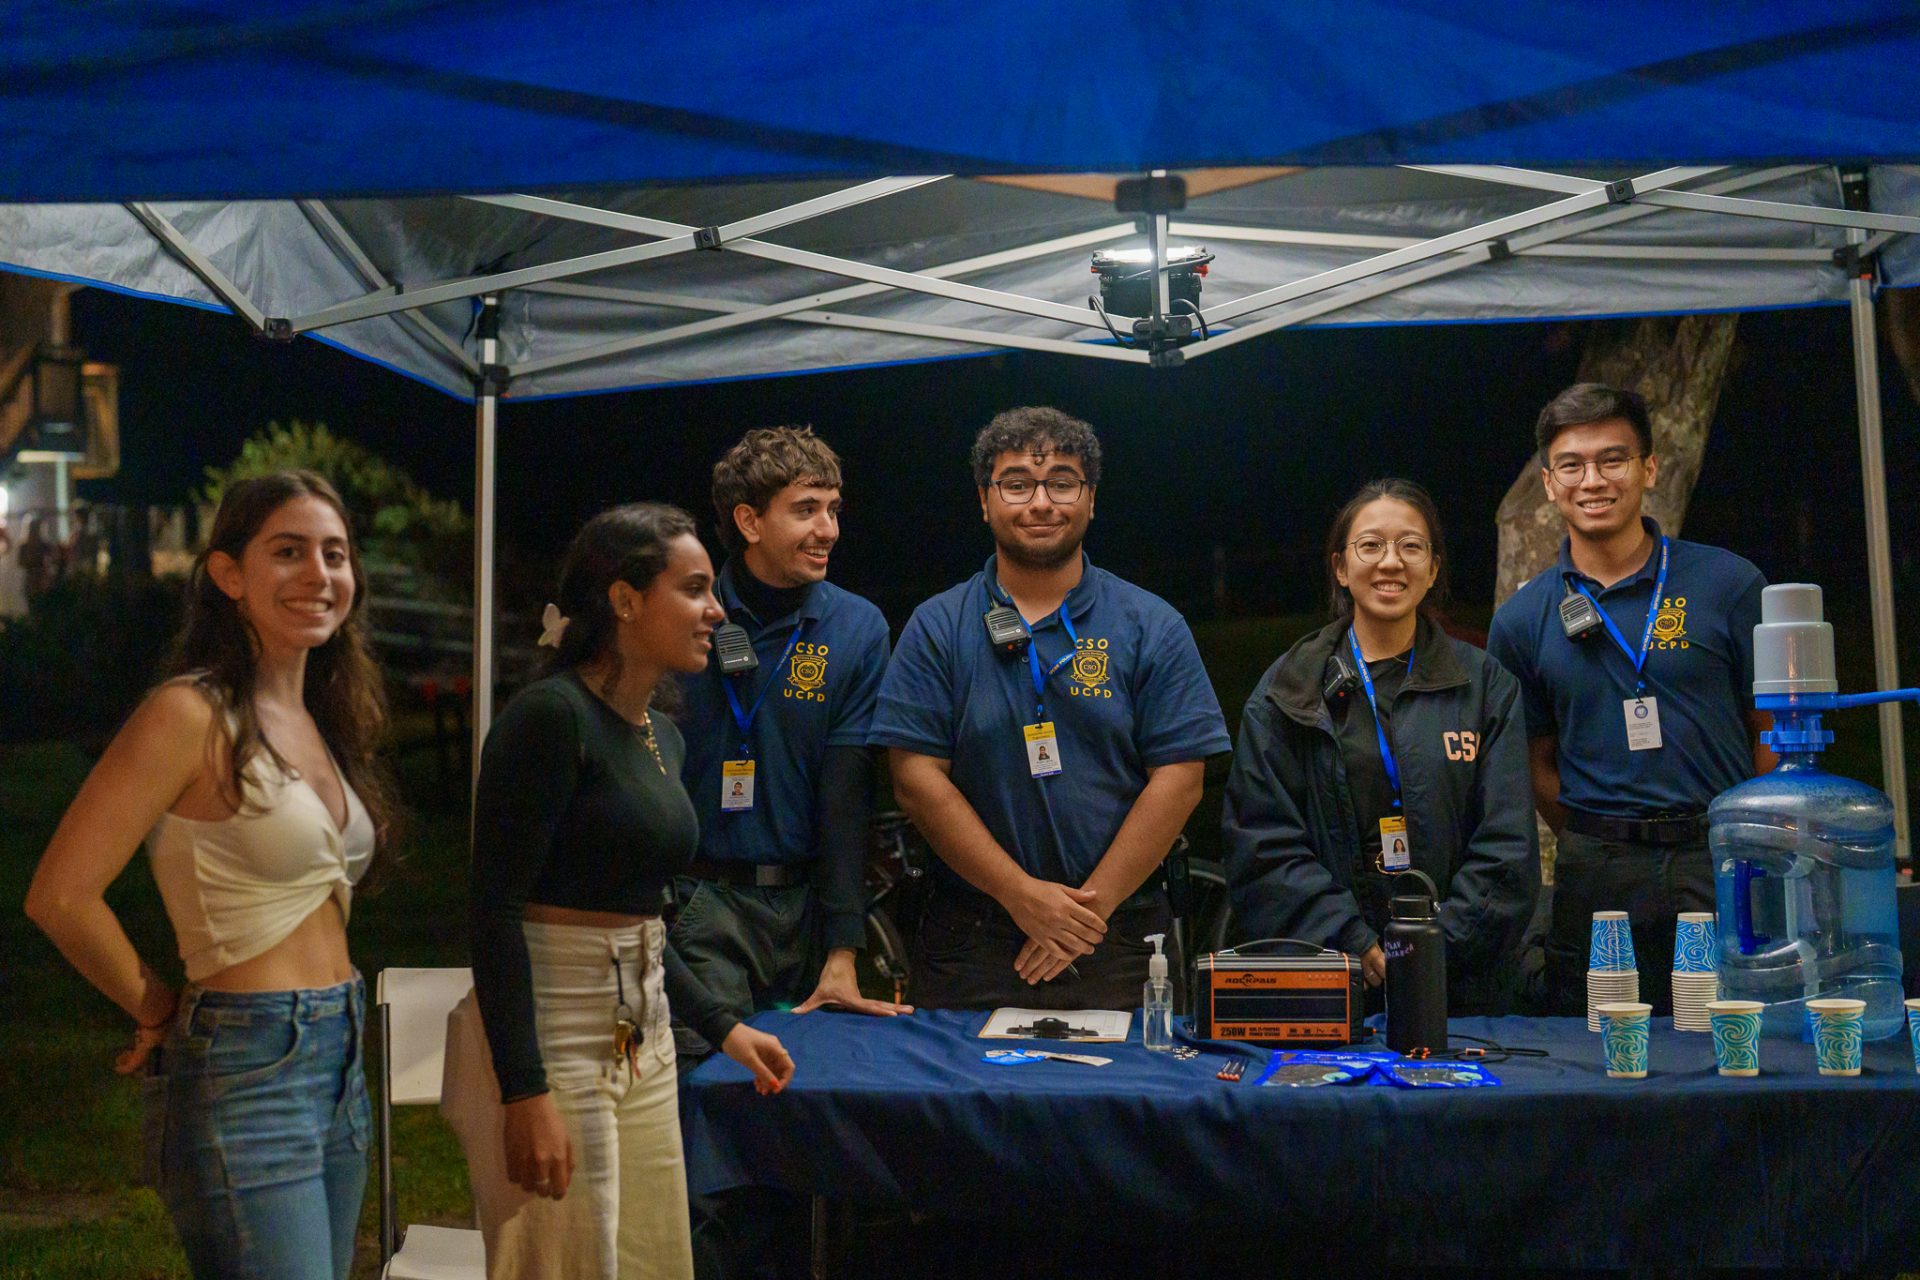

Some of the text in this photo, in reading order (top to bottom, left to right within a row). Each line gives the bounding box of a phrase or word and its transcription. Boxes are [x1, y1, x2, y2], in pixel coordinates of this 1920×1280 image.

[1663, 597, 1687, 609] SO
[796, 642, 829, 656] CSO
[1076, 638, 1109, 650] CSO
[784, 689, 825, 702] UCPD
[1070, 686, 1112, 699] UCPD
[1443, 731, 1481, 762] CS
[1220, 1027, 1246, 1037] 250W
